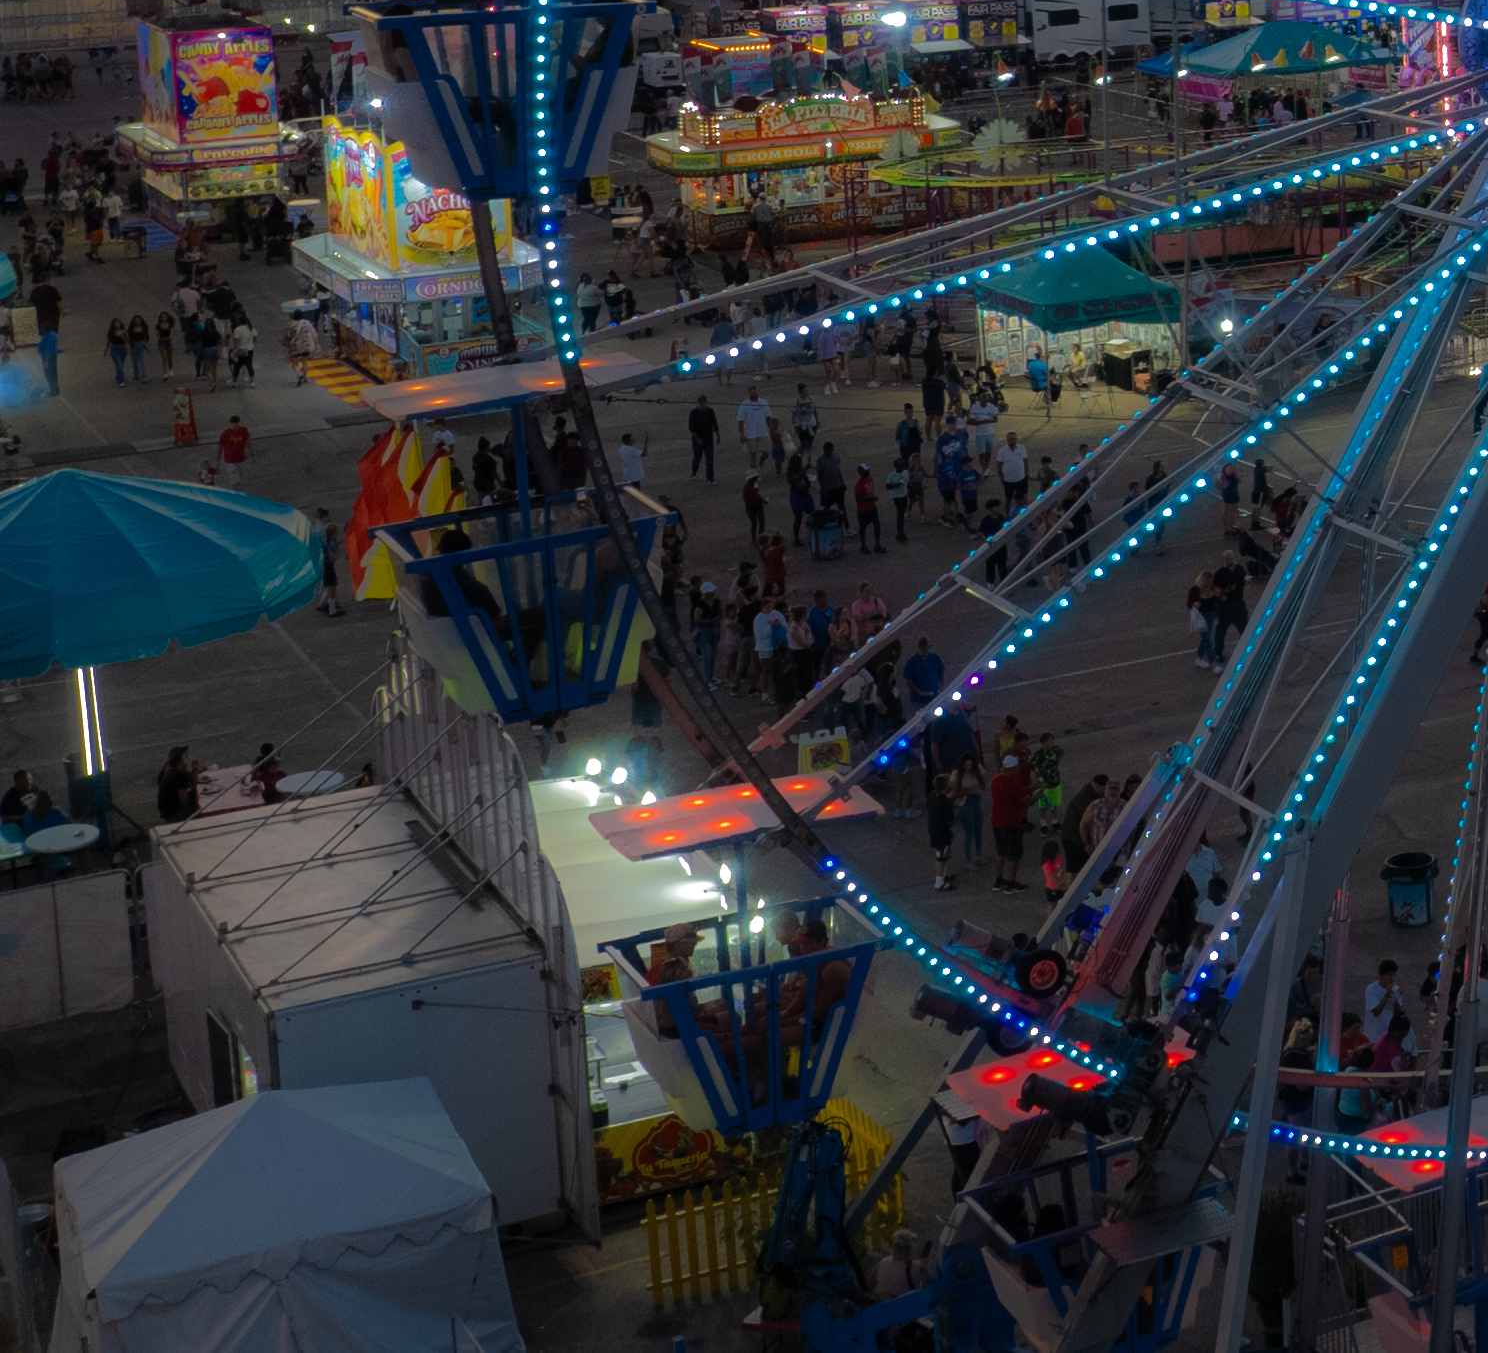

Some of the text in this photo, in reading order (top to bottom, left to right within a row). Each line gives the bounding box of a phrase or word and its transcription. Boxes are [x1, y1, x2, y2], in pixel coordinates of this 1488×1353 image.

[909, 5, 958, 19] FAIR PASS
[967, 1, 1016, 15] FAIR PASS
[776, 16, 827, 31] FAIR PASS
[842, 13, 863, 25] FAIR
[178, 37, 270, 59] CANDY APPLES
[767, 103, 867, 130] LA PIZZERIA
[202, 146, 270, 159] POPCORN
